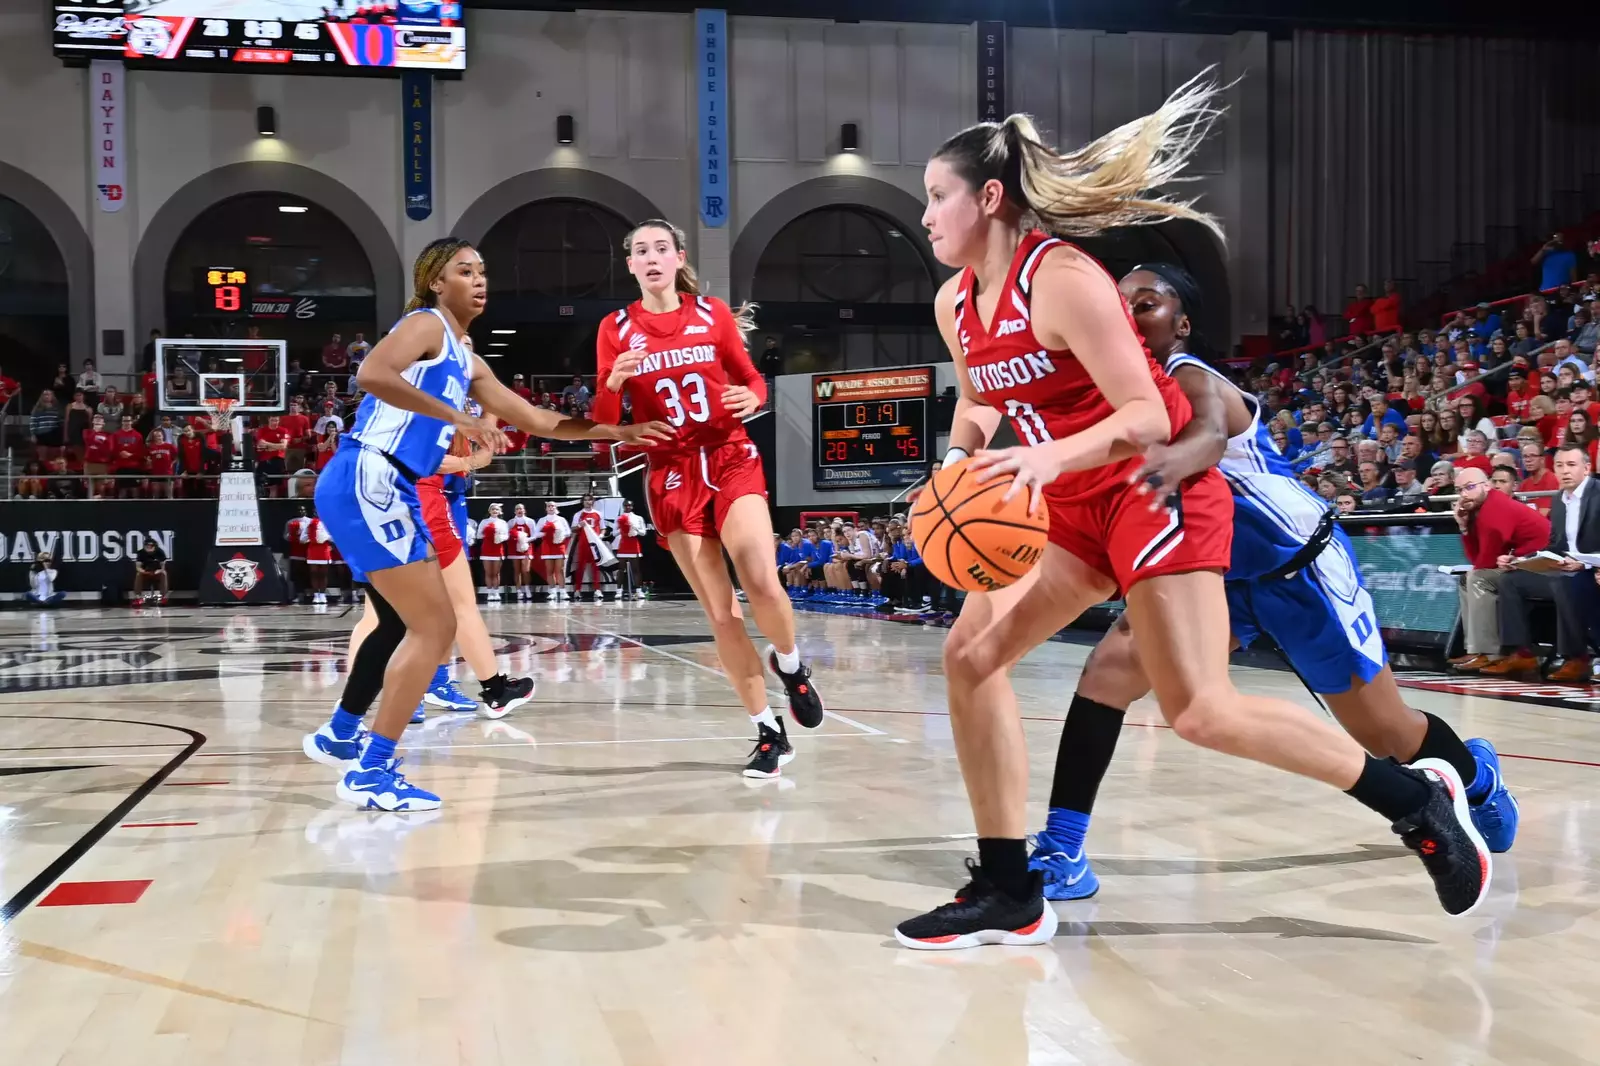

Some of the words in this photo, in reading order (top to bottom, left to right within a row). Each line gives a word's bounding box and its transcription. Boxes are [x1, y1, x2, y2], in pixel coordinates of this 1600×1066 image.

[706, 23, 716, 92] RHODE
[101, 72, 115, 168] DAYTON
[413, 121, 422, 182] SALLE
[707, 101, 719, 184] ISLAND
[252, 303, 275, 313] TION
[968, 350, 1056, 393] VIDSON
[655, 372, 711, 427] 33
[826, 441, 848, 460] 28
[862, 432, 881, 440] PERIOD
[864, 443, 875, 456] 4
[896, 437, 919, 457] 45
[379, 519, 407, 543] D
[1351, 611, 1373, 647] D
